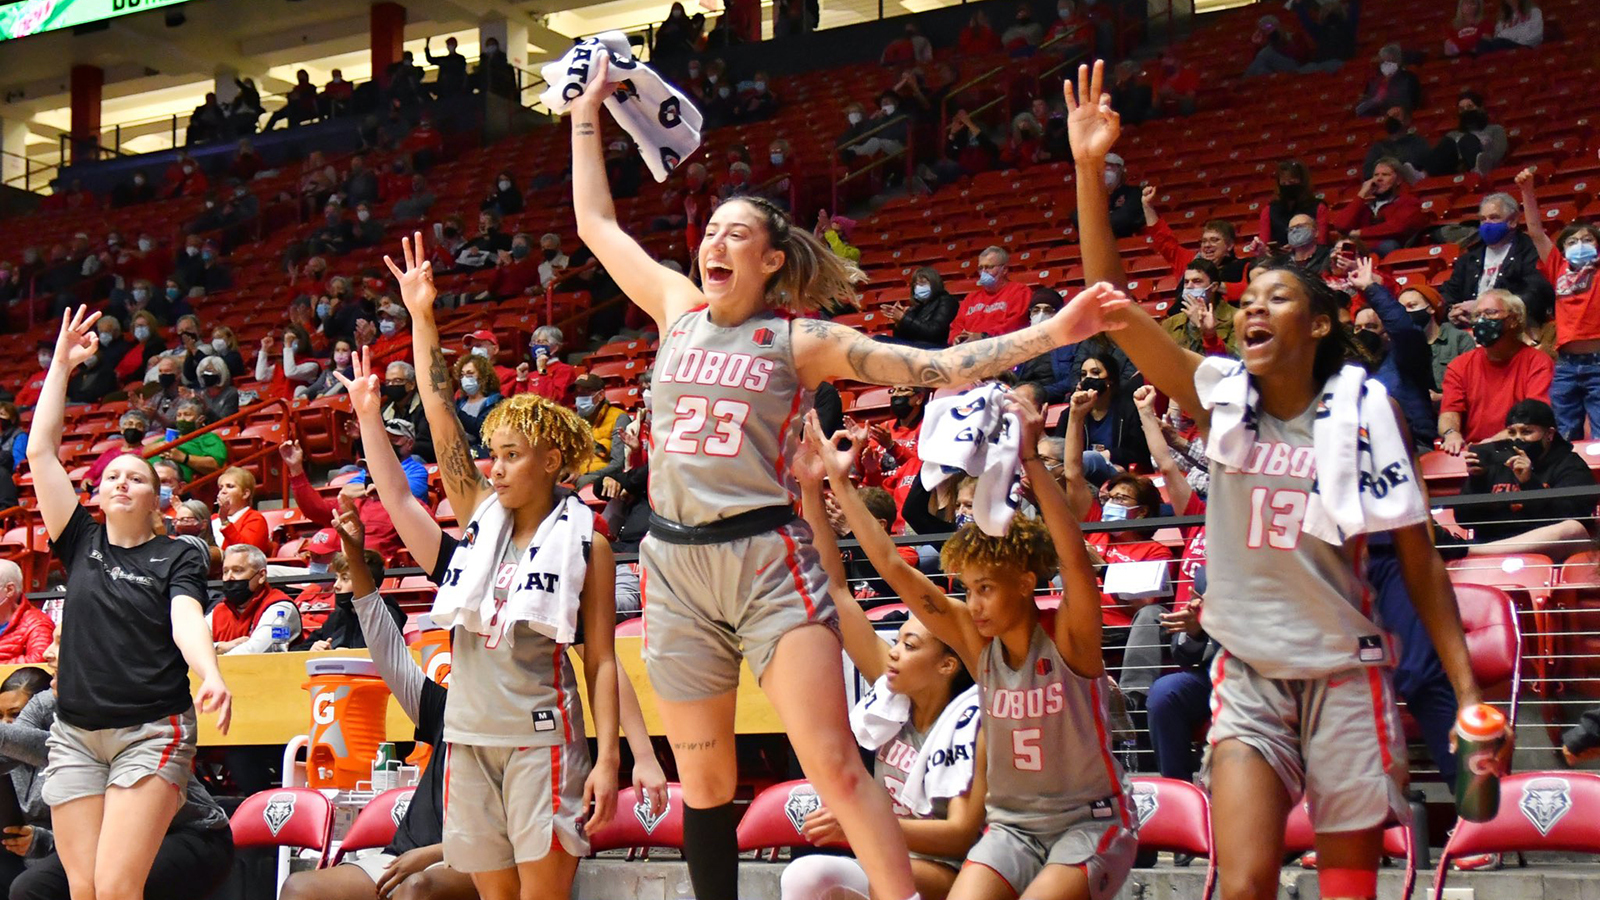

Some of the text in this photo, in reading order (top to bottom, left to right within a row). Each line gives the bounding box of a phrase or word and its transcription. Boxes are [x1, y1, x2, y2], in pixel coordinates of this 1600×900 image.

[659, 347, 775, 393] LOBOS
[664, 394, 751, 458] 23
[1247, 486, 1309, 551] 13
[538, 712, 547, 720] M
[1012, 726, 1044, 772] 5
